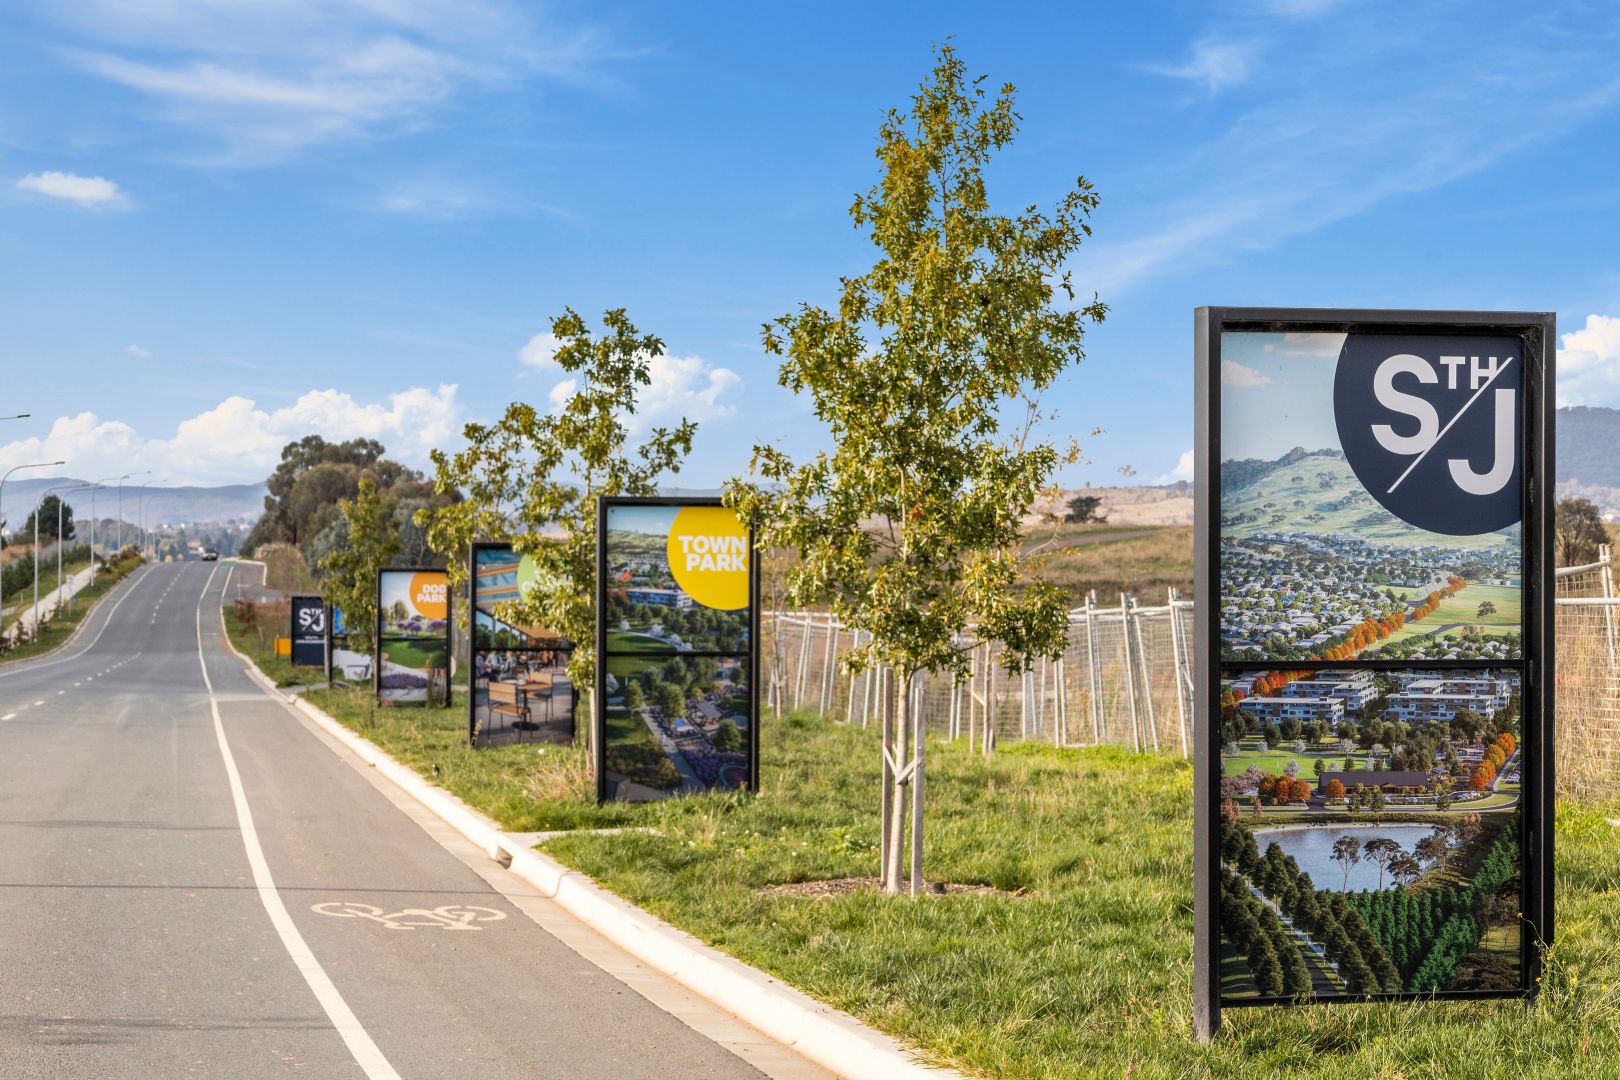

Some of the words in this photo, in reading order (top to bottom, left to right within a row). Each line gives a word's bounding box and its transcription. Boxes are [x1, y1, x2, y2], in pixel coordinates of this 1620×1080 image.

[678, 535, 747, 554] TOWN
[686, 553, 747, 572] PARK
[422, 584, 447, 594] DOG
[416, 593, 447, 603] PARK
